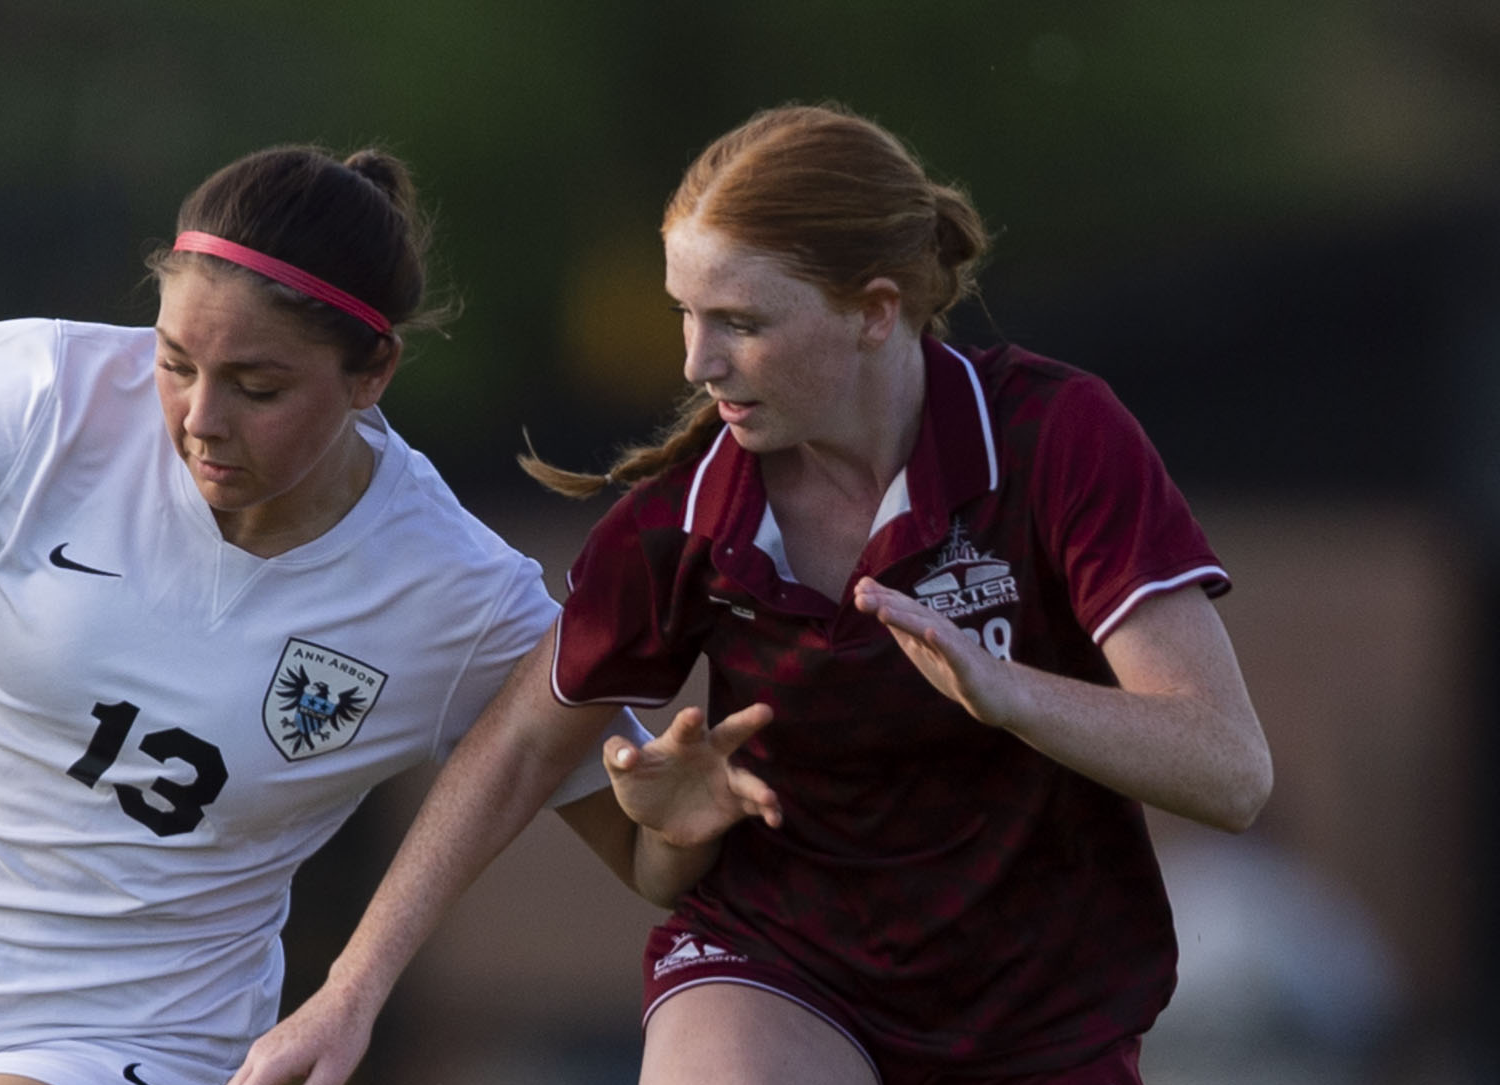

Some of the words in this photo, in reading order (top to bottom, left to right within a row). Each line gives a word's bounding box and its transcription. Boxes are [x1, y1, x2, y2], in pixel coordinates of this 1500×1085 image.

[293, 648, 325, 664] ANN
[328, 658, 376, 687] ARBOR
[66, 700, 229, 837] 13
